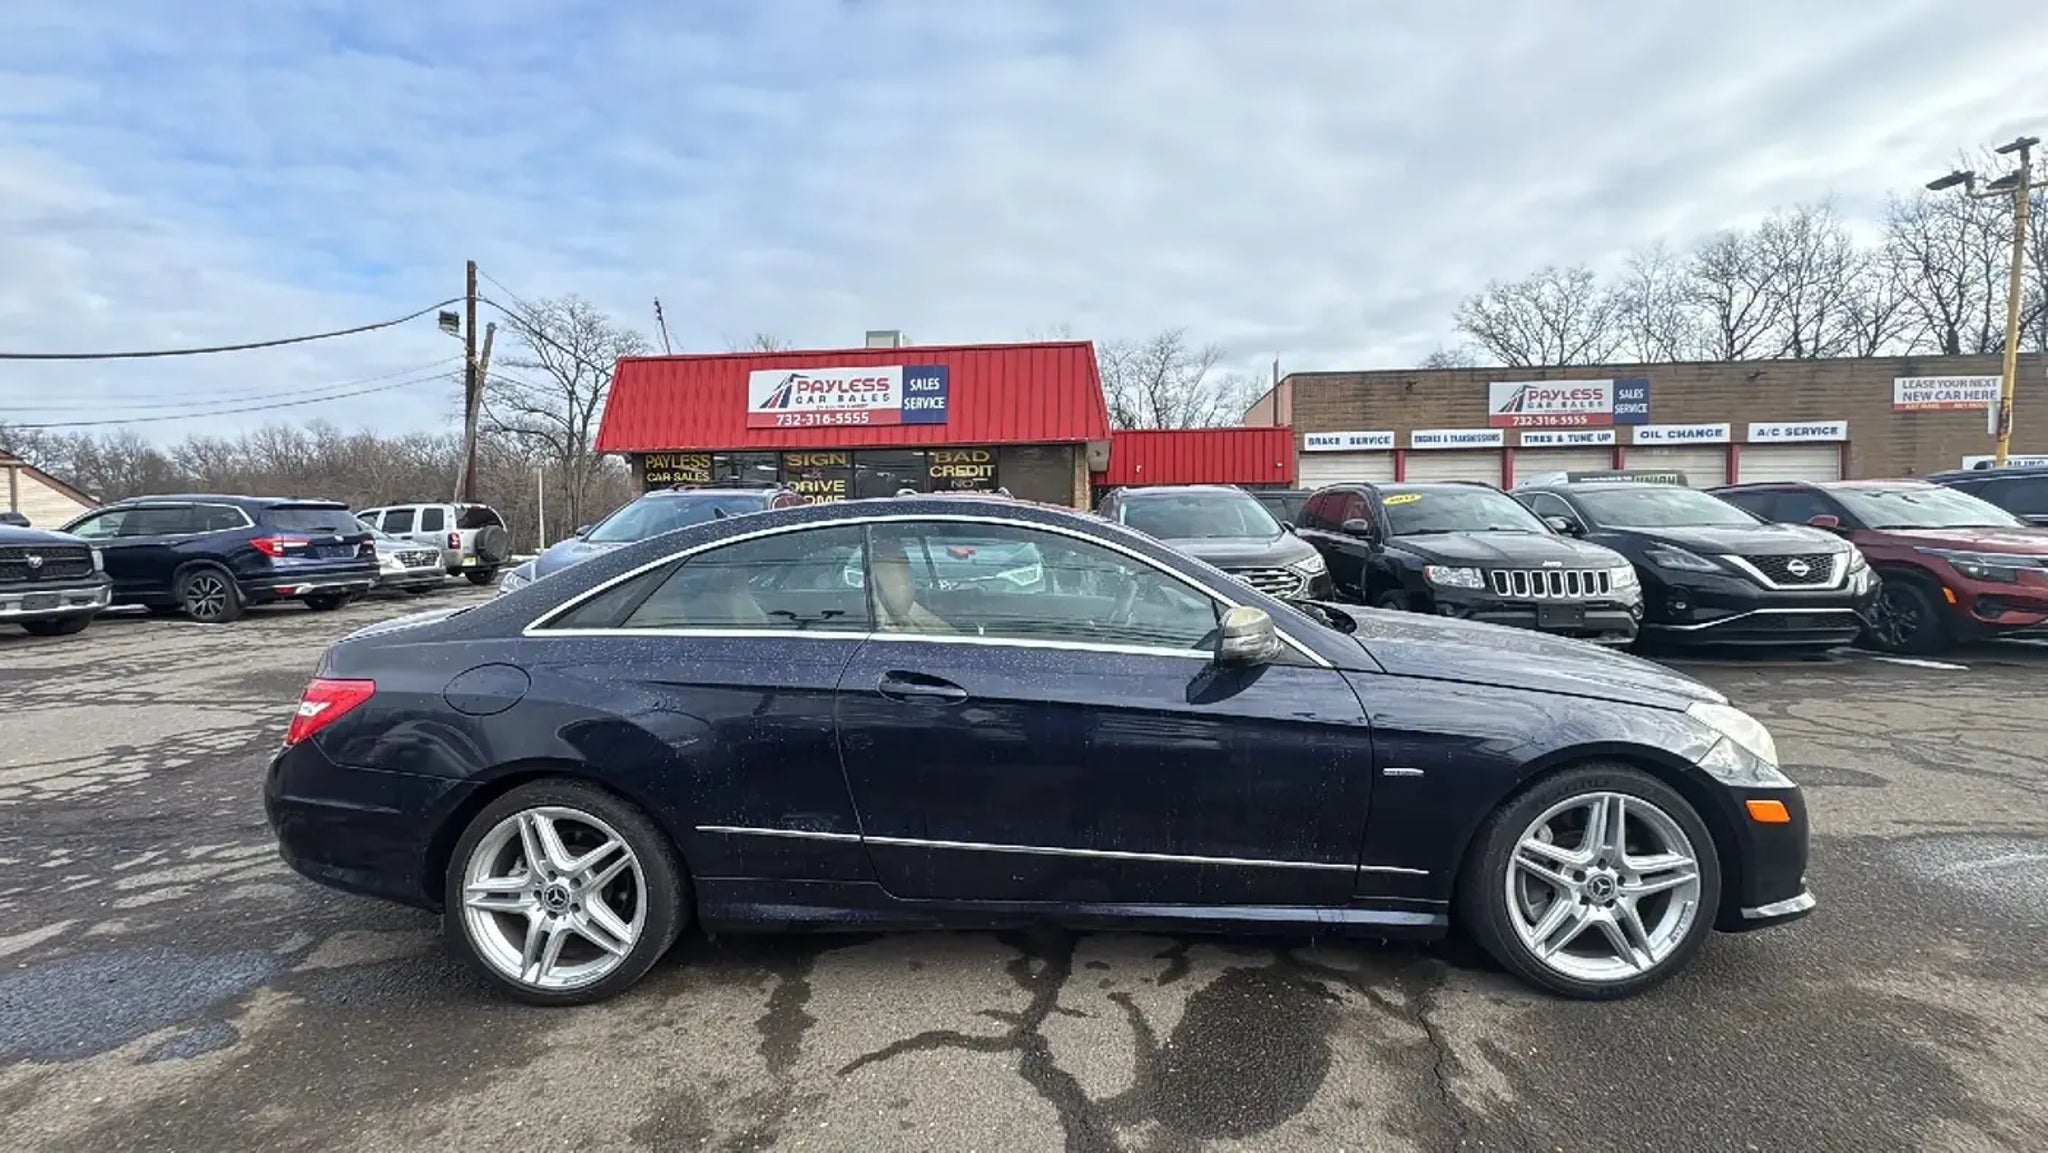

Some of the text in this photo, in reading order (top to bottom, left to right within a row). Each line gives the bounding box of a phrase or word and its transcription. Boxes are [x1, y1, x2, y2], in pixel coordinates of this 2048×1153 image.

[797, 377, 890, 393] PAYLESS
[909, 377, 940, 391] SALES
[1902, 378, 1997, 389] LEASE YOUR NEXT
[795, 393, 890, 404] CAR SALES
[1529, 389, 1603, 401] PAYLESS
[1619, 389, 1644, 399] SALES
[1902, 389, 1997, 402] NEW CAR HERE
[904, 397, 945, 410] SERVICE
[1614, 403, 1648, 414] SERVICE
[776, 412, 869, 425] 732-316-5555
[1512, 417, 1588, 426] 732-316-5555
[1640, 428, 1723, 439] OIL CHANGE
[1757, 426, 1838, 437] A/C SERVICE
[1308, 436, 1391, 445] BRAKE SERVICE
[1524, 435, 1553, 443] TIRES
[1568, 433, 1594, 442] TUNE
[1597, 433, 1612, 441] UP
[645, 455, 711, 468] PAYLESS
[786, 453, 846, 466] SIGN
[934, 451, 990, 463] BAD
[646, 471, 710, 482] CAR SALES
[930, 465, 996, 478] CREDIT
[787, 480, 846, 493] DRIVE
[951, 480, 974, 488] NO
